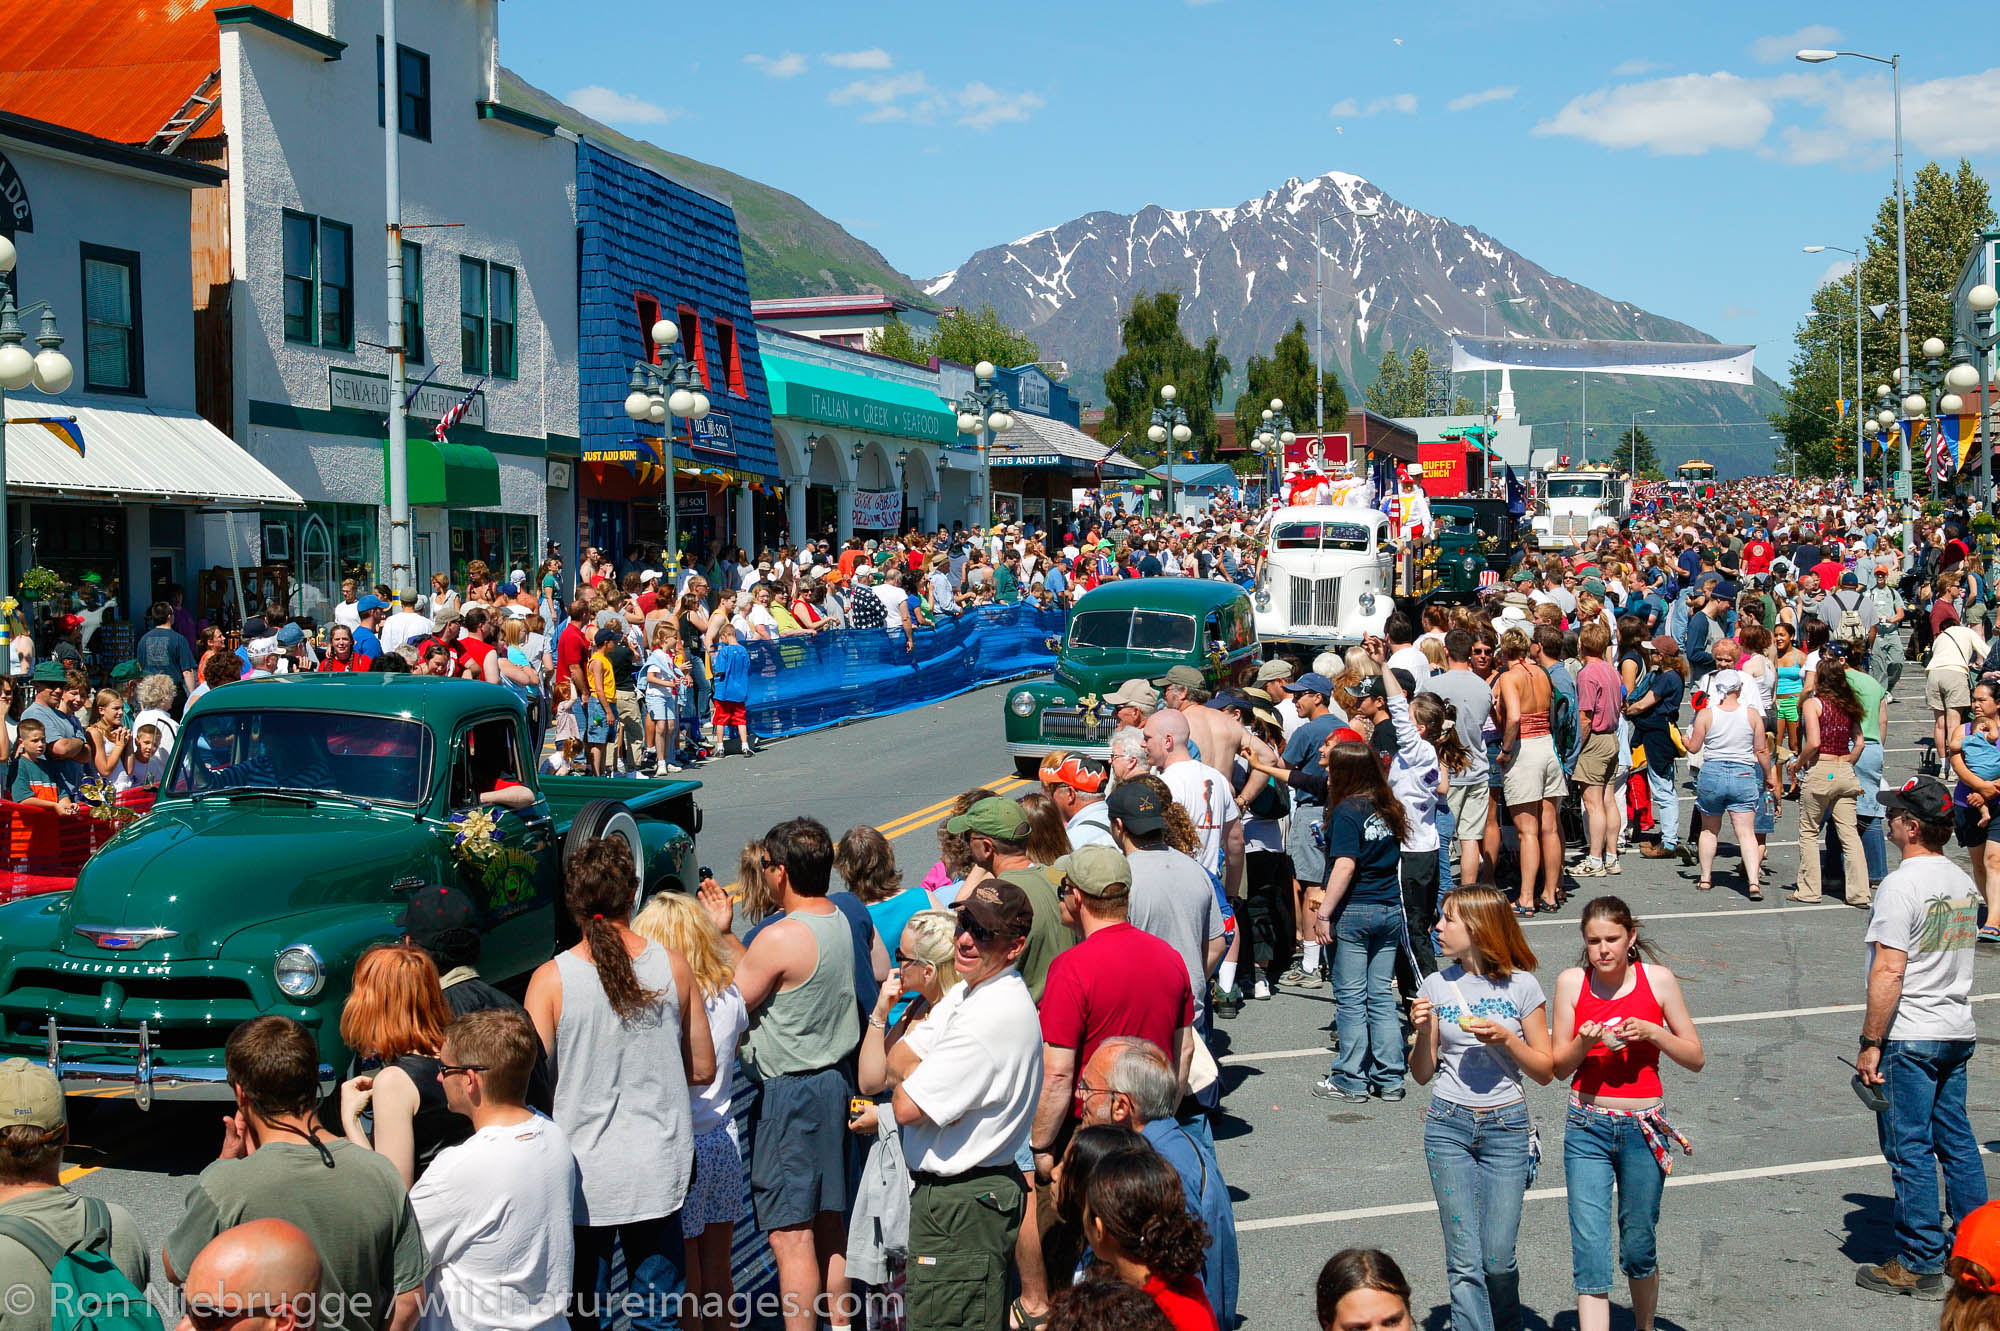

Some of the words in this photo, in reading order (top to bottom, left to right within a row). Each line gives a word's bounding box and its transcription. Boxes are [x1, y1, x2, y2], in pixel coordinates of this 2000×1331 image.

[334, 377, 389, 406] SEWARD
[810, 393, 849, 419] ITALIAN
[862, 403, 889, 427] GREEK
[902, 411, 939, 435] SEAFOOD
[694, 419, 708, 434] DEL
[714, 423, 729, 438] SOL
[583, 450, 602, 462] JUST
[602, 450, 619, 462] ADD
[619, 449, 637, 461] SUN!
[988, 456, 1013, 465] GIFTS
[1015, 456, 1036, 465] AND
[1038, 455, 1059, 465] FILM
[1422, 460, 1457, 470] BUFFET
[1422, 469, 1450, 478] LUNCH
[689, 497, 704, 506] SOL
[62, 961, 172, 975] CHEVROLET
[14, 1106, 33, 1116] Paul
